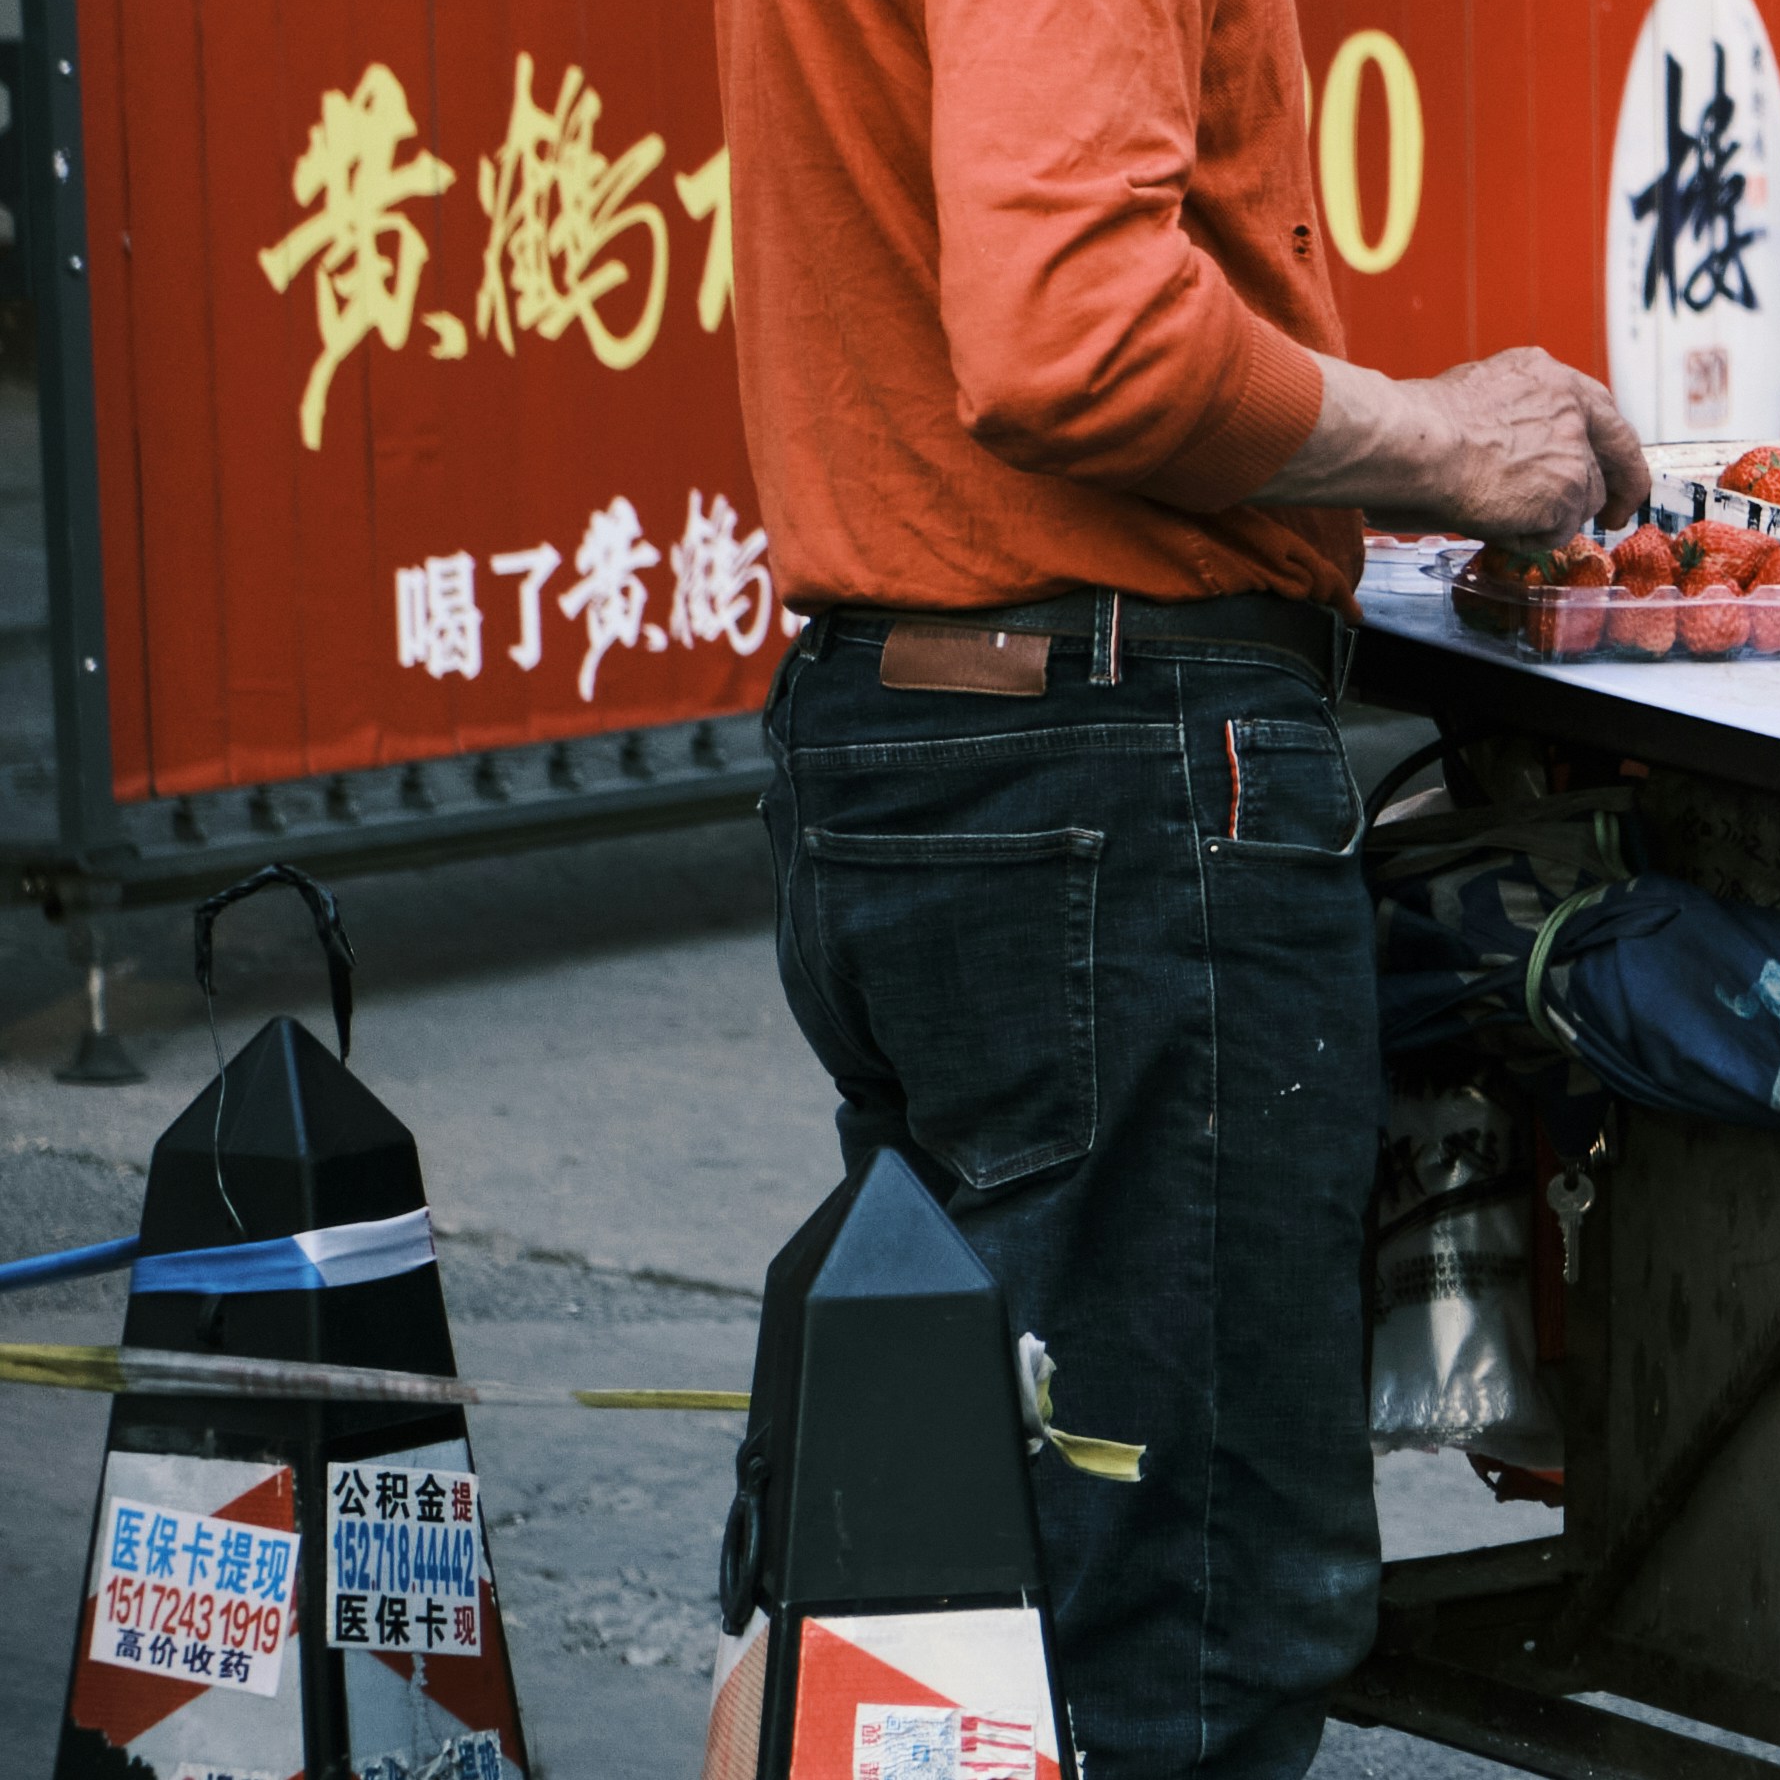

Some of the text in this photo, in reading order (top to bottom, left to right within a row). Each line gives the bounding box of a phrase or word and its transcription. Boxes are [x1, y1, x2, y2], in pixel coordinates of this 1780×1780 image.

[394, 486, 810, 702] 喝了黄鹤
[111, 1507, 291, 1603] 医保卡提现
[115, 1628, 253, 1683] 高价收药
